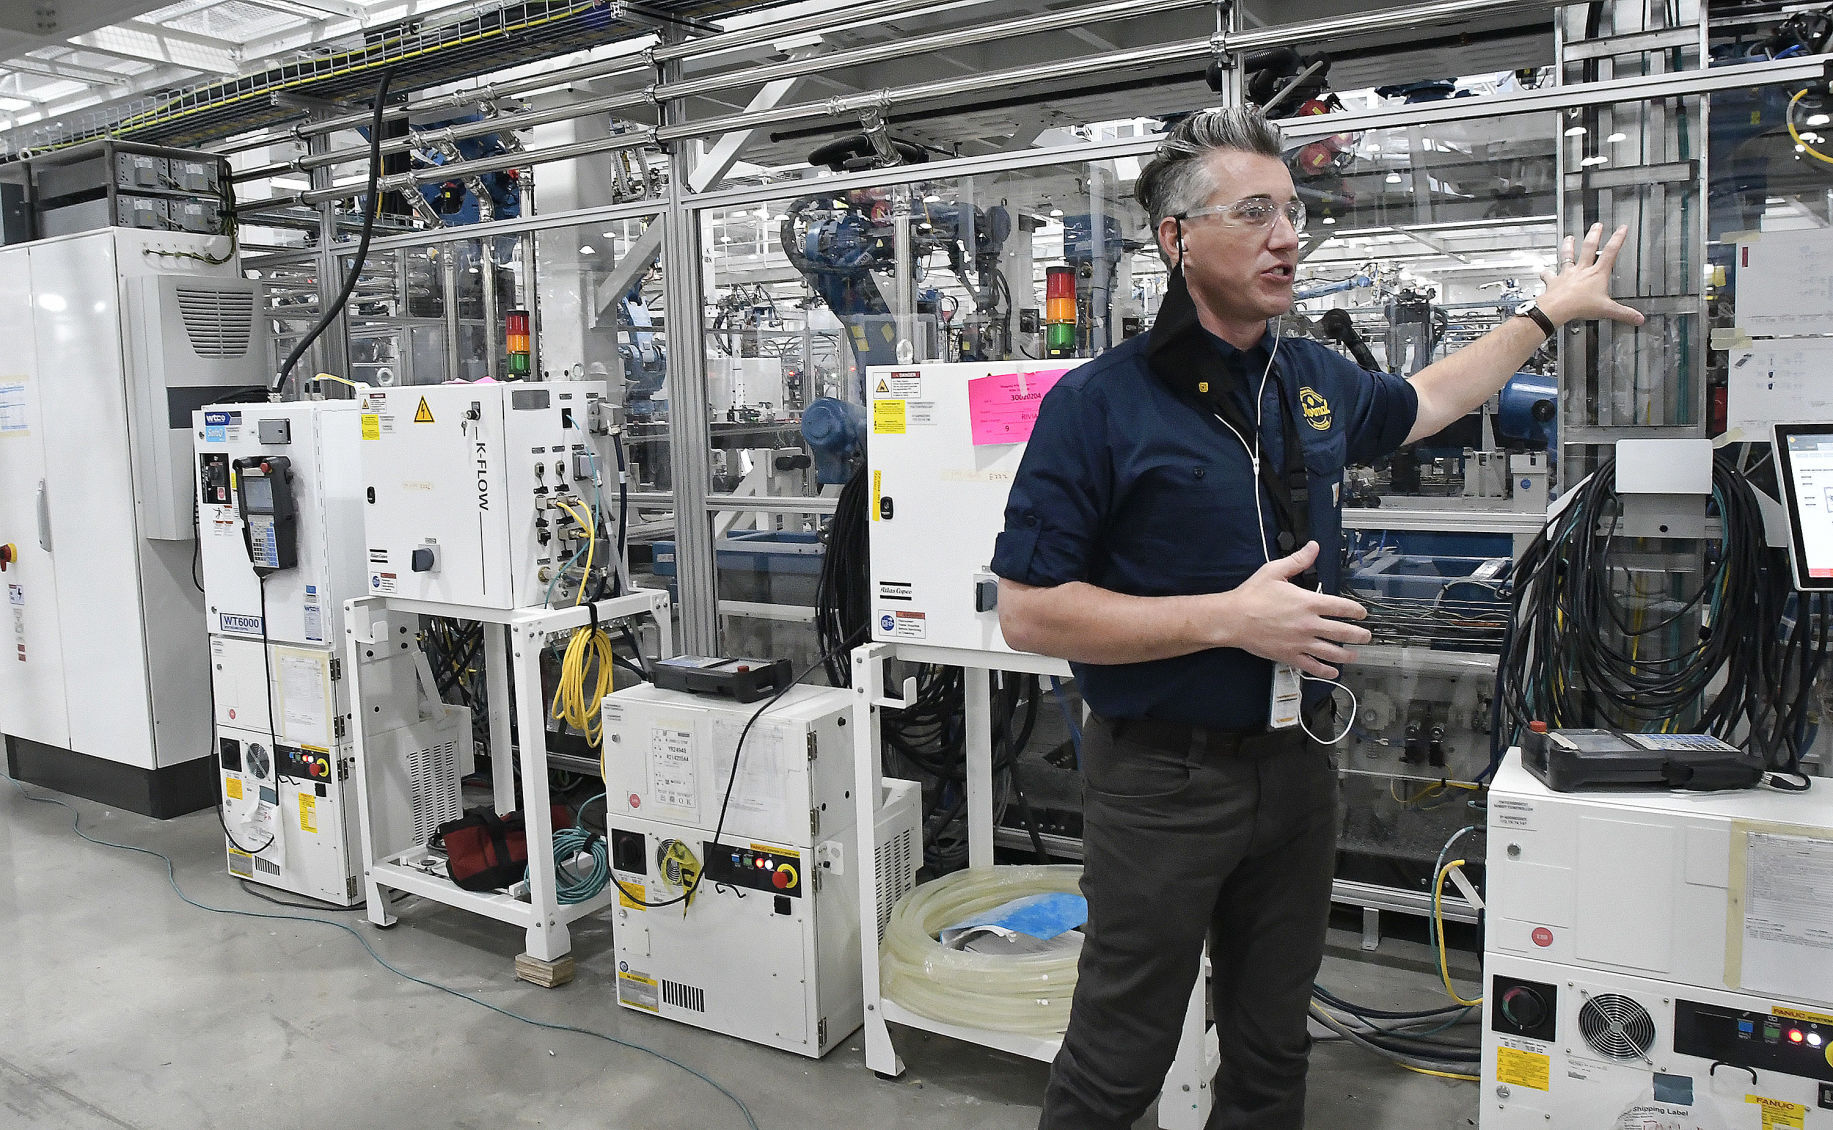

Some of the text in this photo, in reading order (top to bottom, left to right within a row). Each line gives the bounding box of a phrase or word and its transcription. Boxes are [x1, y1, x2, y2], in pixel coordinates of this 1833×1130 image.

[476, 443, 489, 511] K-FLOW
[223, 616, 260, 628] WT6000
[1773, 1008, 1805, 1018] FANUC
[1756, 1097, 1794, 1110] FANUC
[1632, 1105, 1689, 1117] Shipping Label
